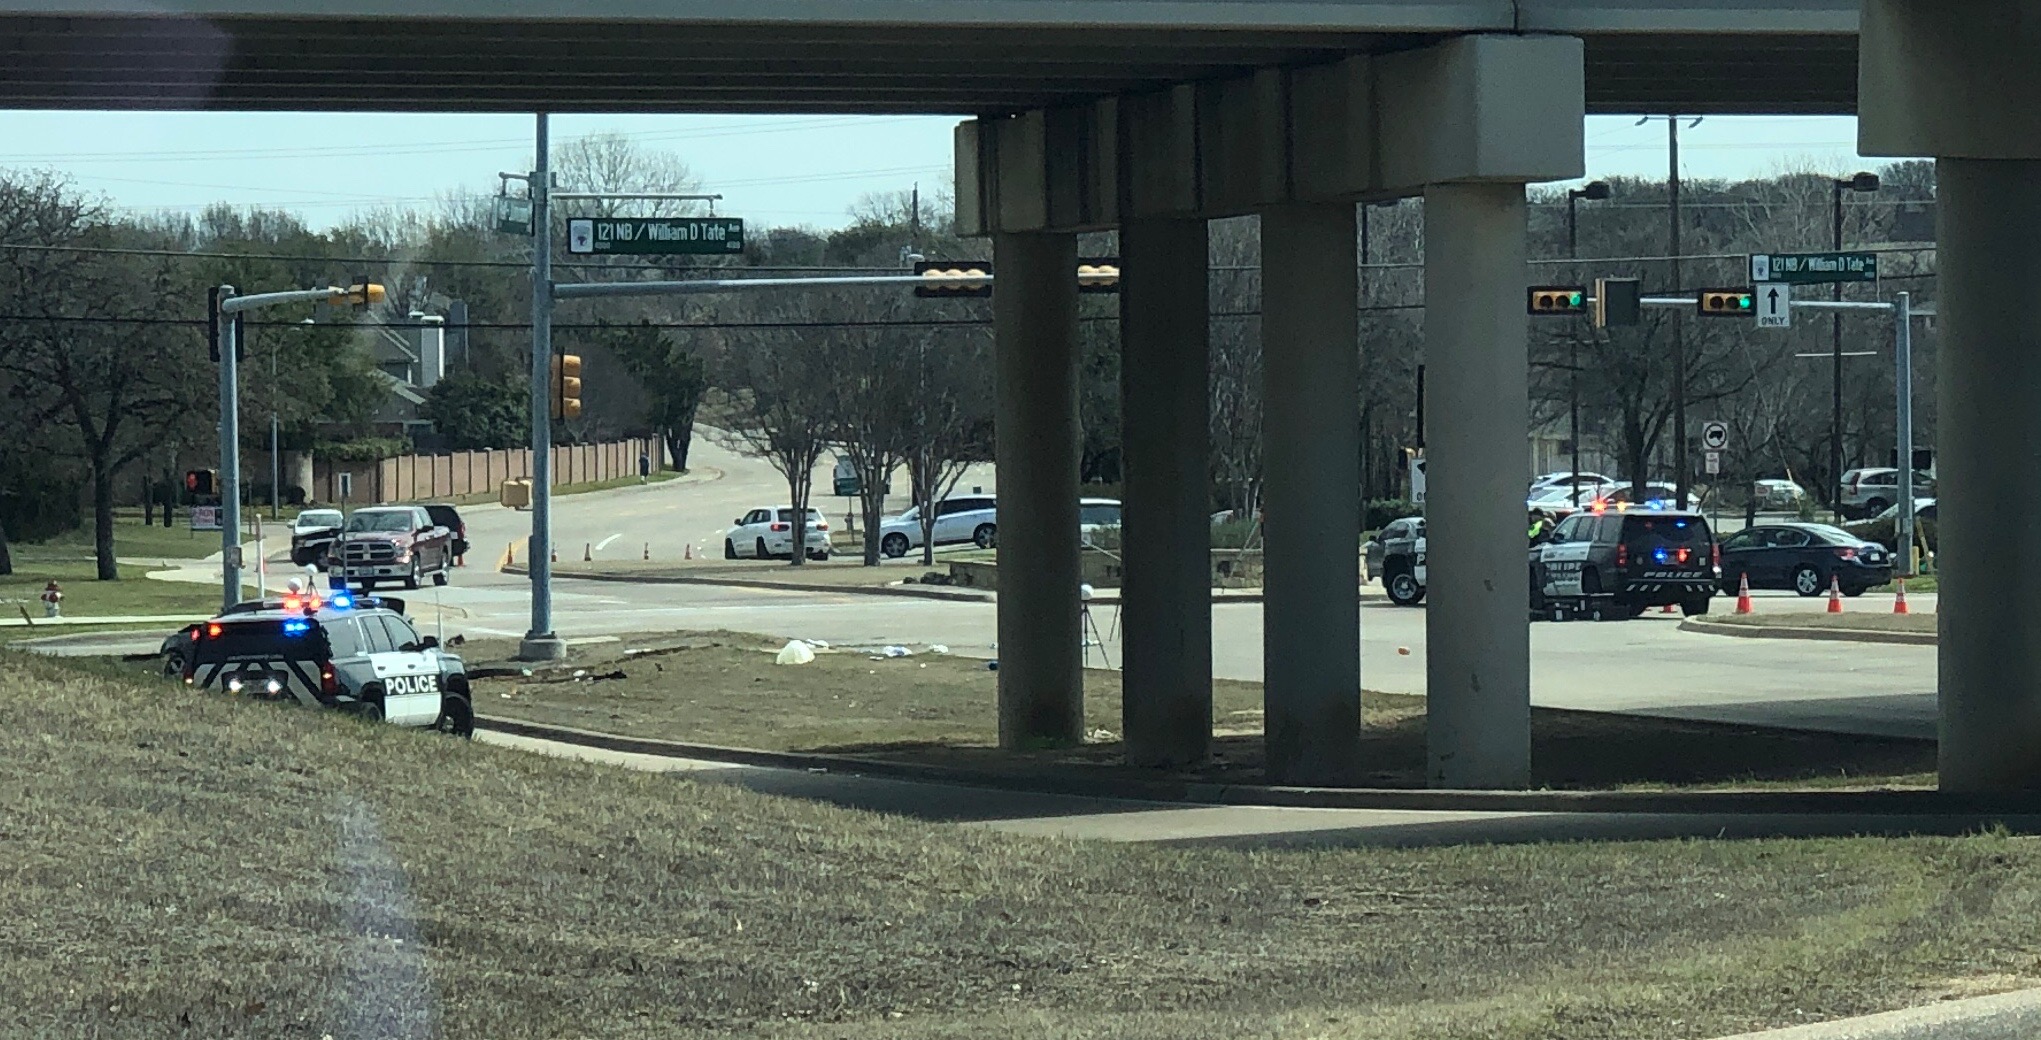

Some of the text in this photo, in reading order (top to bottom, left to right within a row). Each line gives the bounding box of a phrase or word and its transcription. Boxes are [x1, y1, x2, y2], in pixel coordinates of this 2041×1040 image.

[597, 223, 614, 240] 121
[617, 223, 633, 240] NB
[648, 222, 688, 240] William
[690, 223, 698, 240] D
[701, 223, 726, 240] Tate
[1772, 257, 1784, 271] 121
[1808, 257, 1837, 271] William
[1847, 257, 1864, 271] Tate
[1761, 317, 1785, 326] ONLY
[384, 675, 438, 694] POLICE
